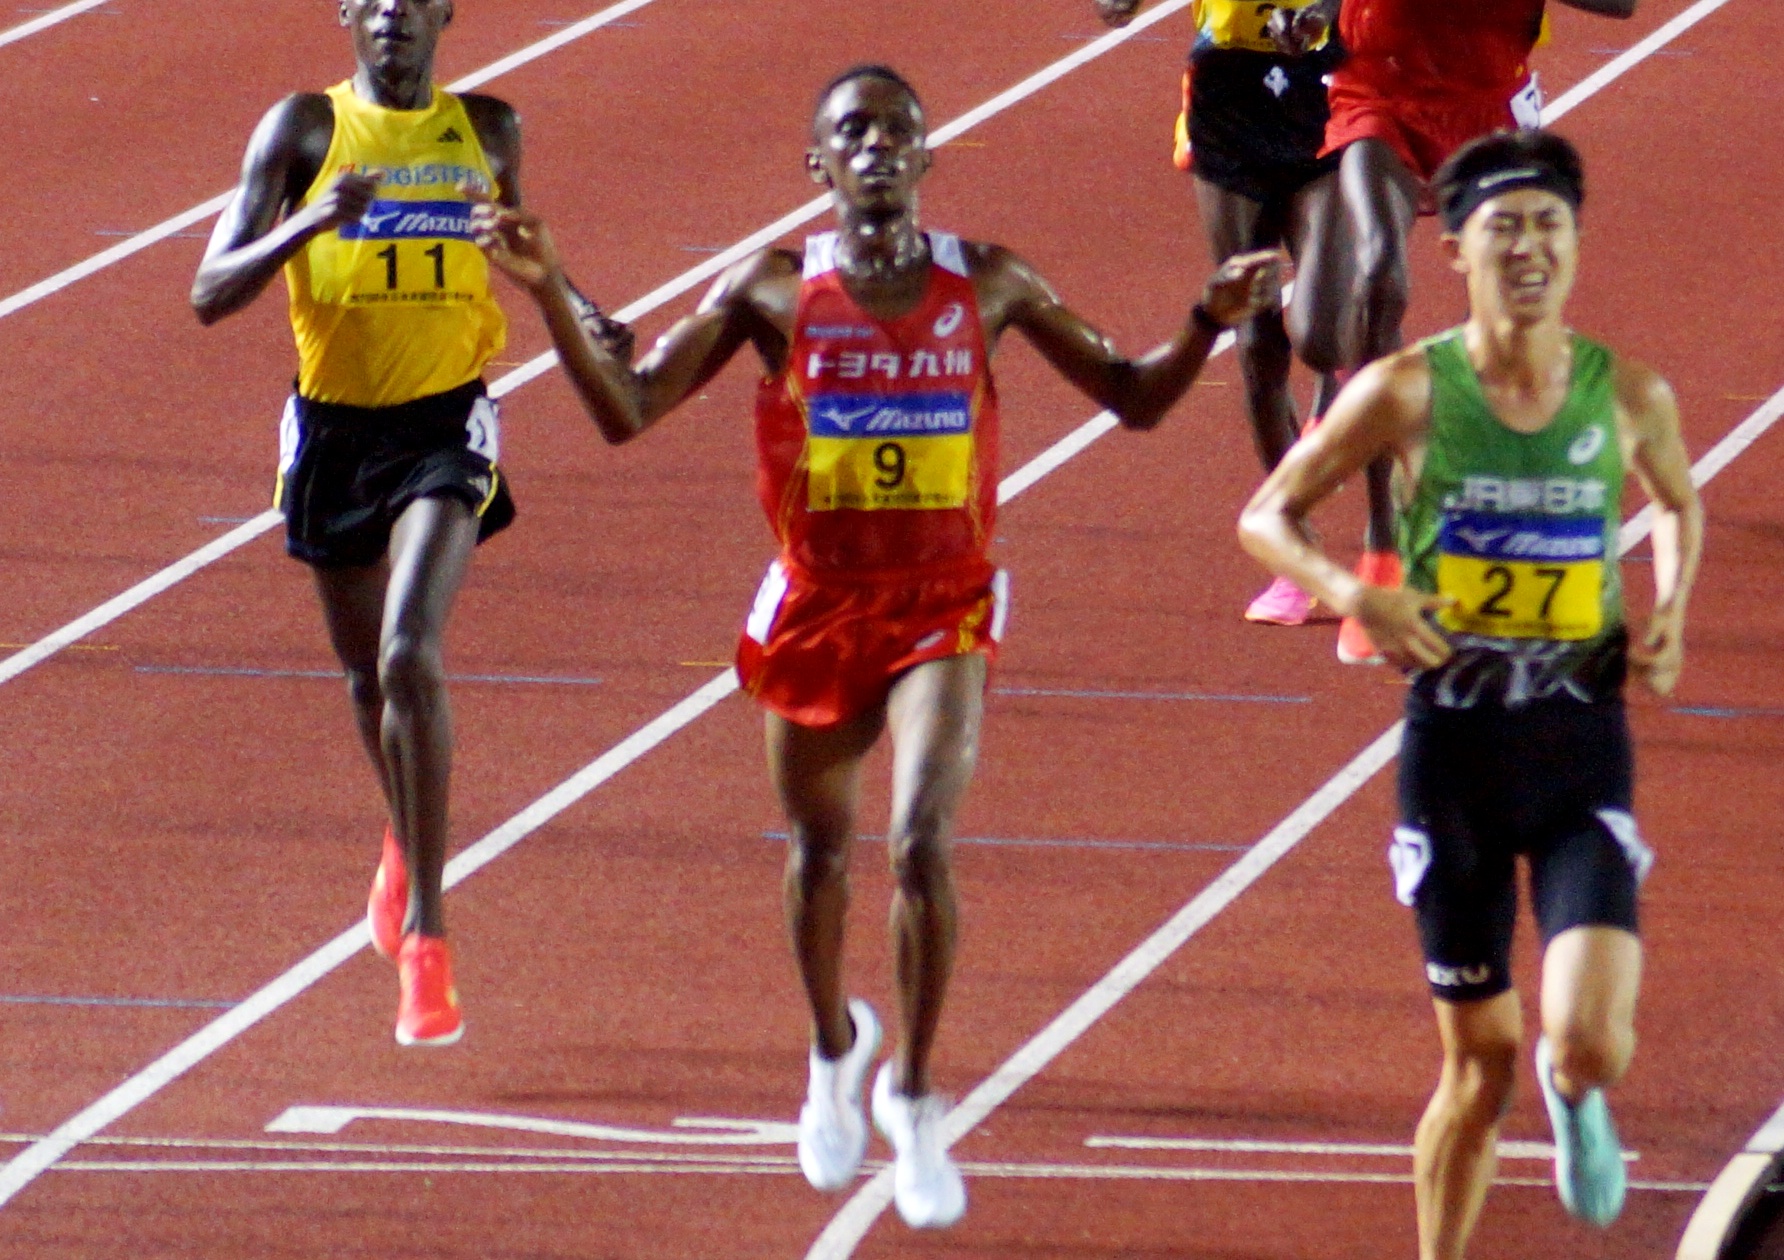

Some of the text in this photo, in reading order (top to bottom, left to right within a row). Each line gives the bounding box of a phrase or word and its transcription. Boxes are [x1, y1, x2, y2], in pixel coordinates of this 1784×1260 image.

[376, 243, 446, 289] 11
[806, 348, 973, 380] トヨタ九州
[873, 441, 906, 489] 9
[1479, 566, 1567, 618] 27
